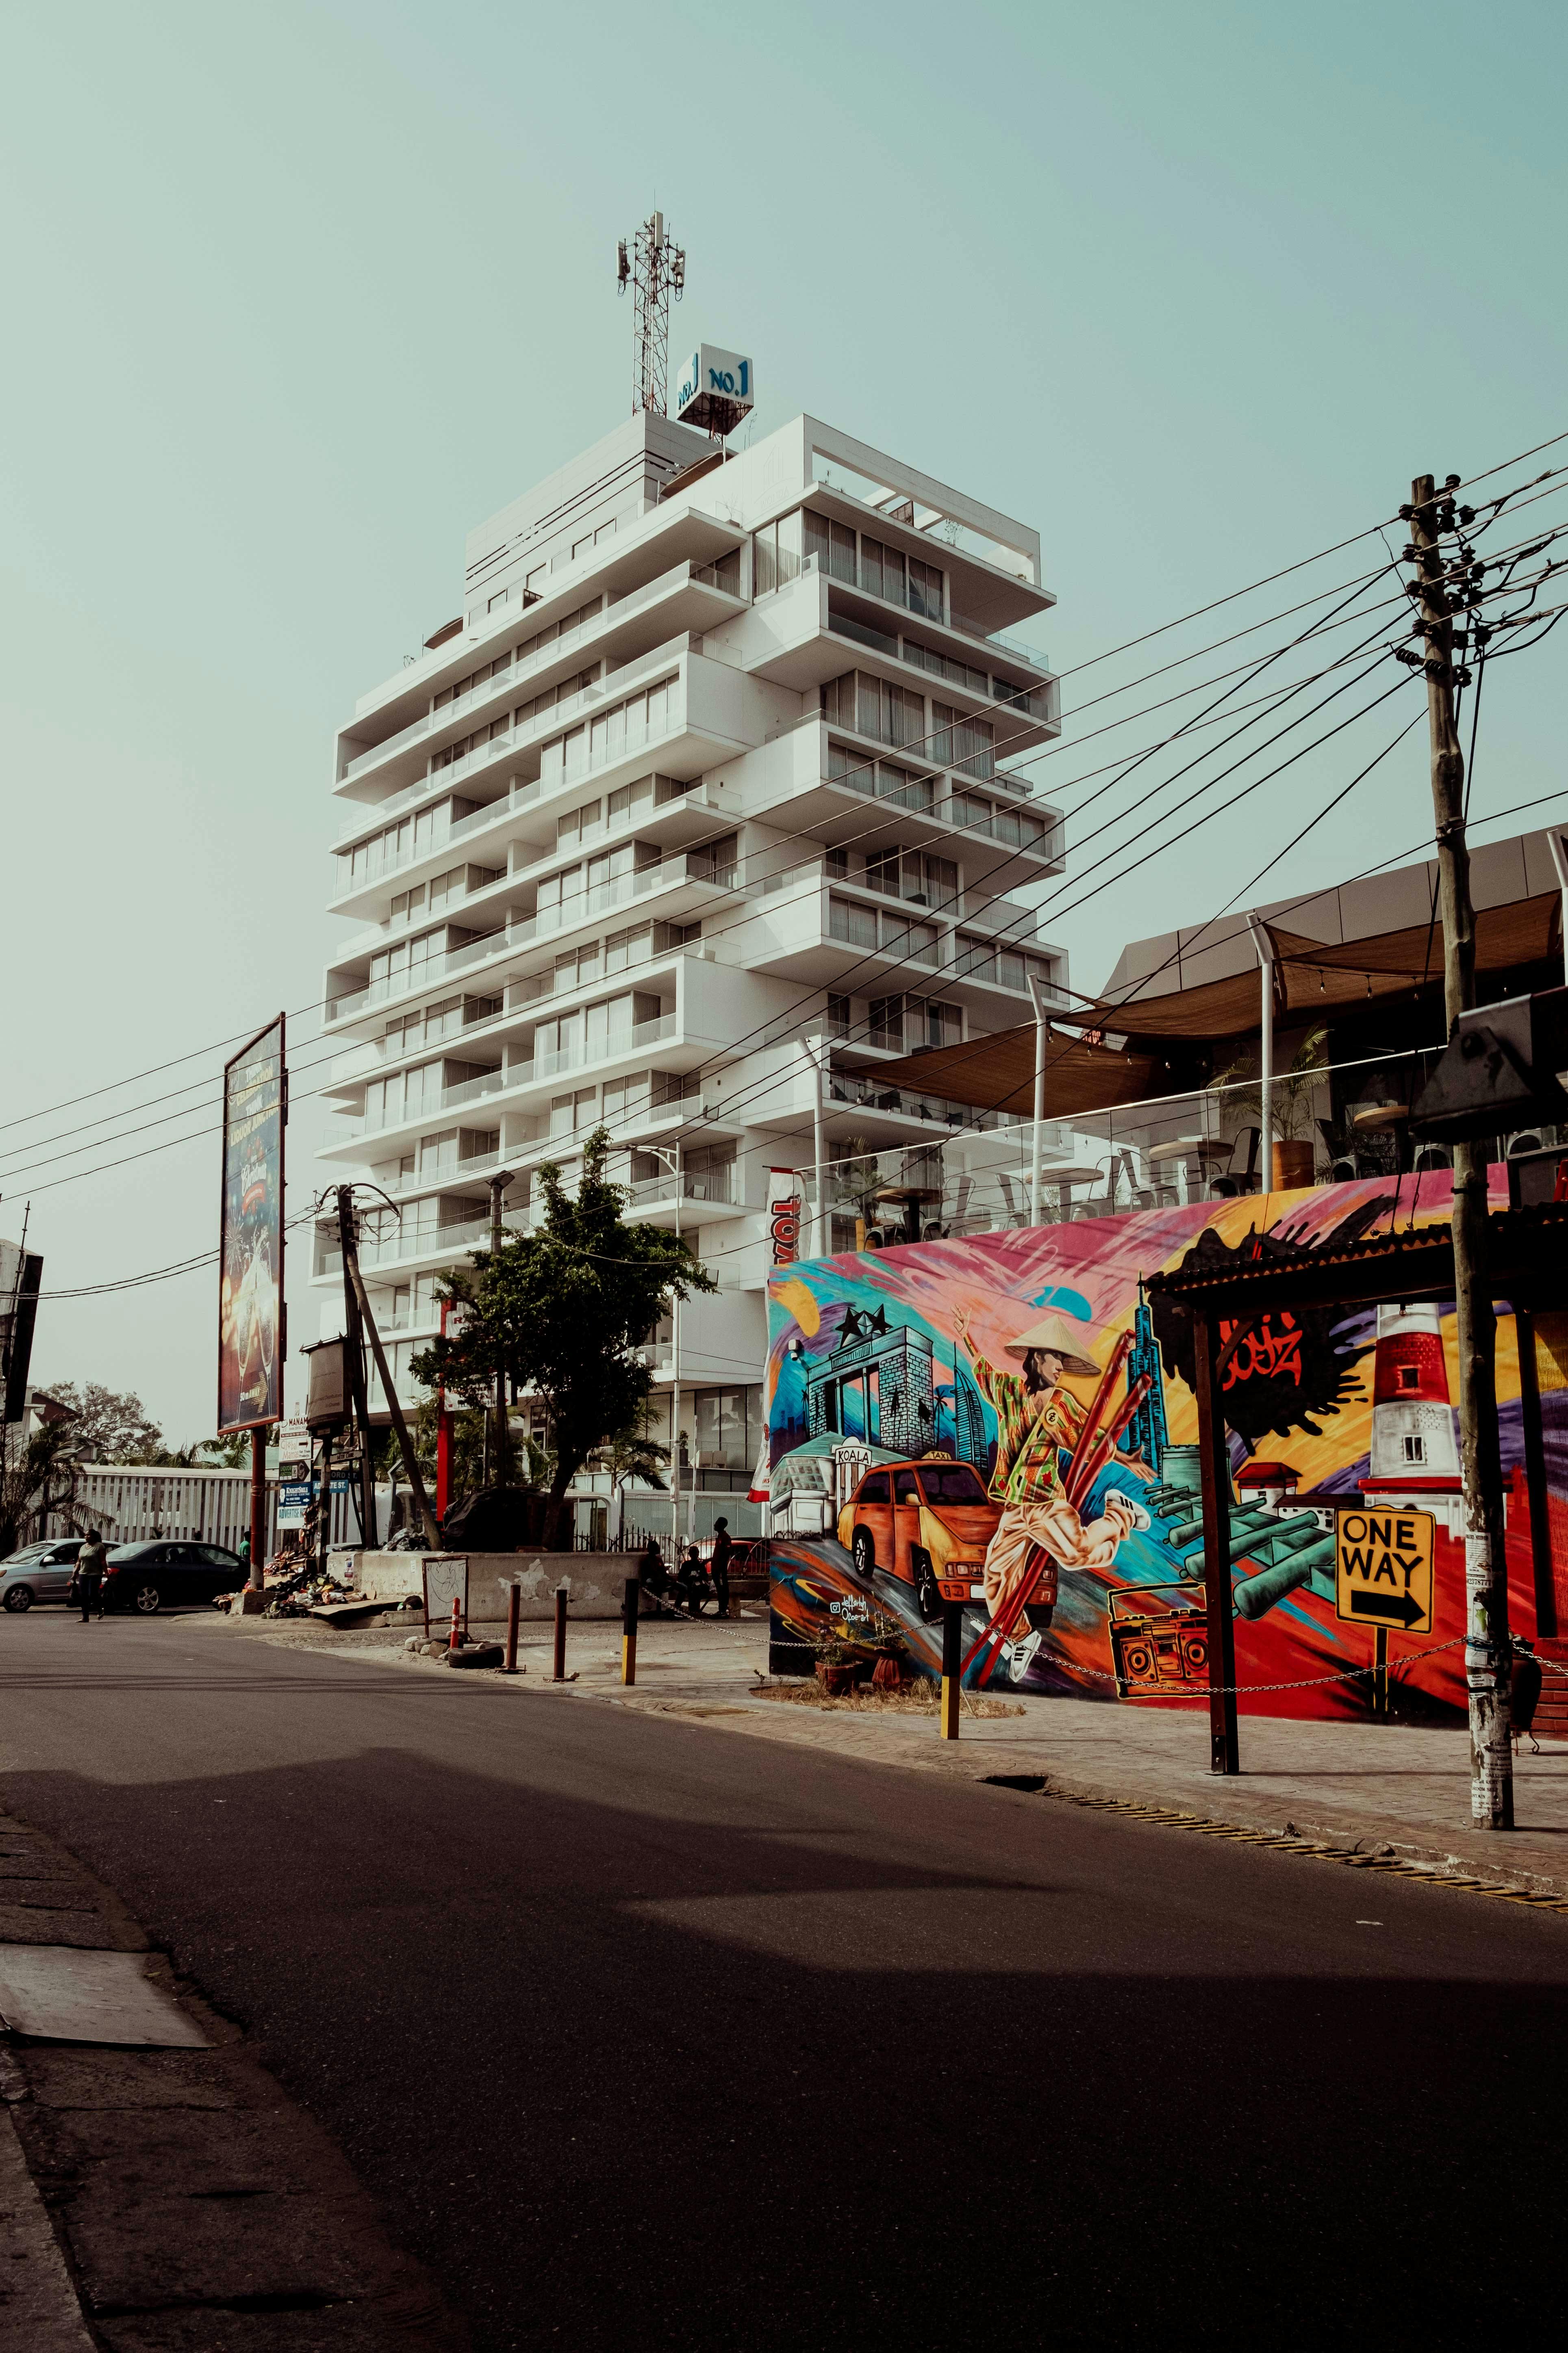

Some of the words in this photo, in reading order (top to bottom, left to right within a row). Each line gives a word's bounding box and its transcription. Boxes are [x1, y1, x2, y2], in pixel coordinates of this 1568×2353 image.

[709, 360, 748, 397] NO.1
[230, 1120, 251, 1146] LIQUOR
[251, 1096, 278, 1132] JUNCTION
[245, 1094, 263, 1119] THINK
[838, 1450, 869, 1464] KOALA
[279, 1508, 299, 1519] ADVERTISE
[1343, 1516, 1417, 1551] ONE
[1341, 1546, 1424, 1588] WAY
